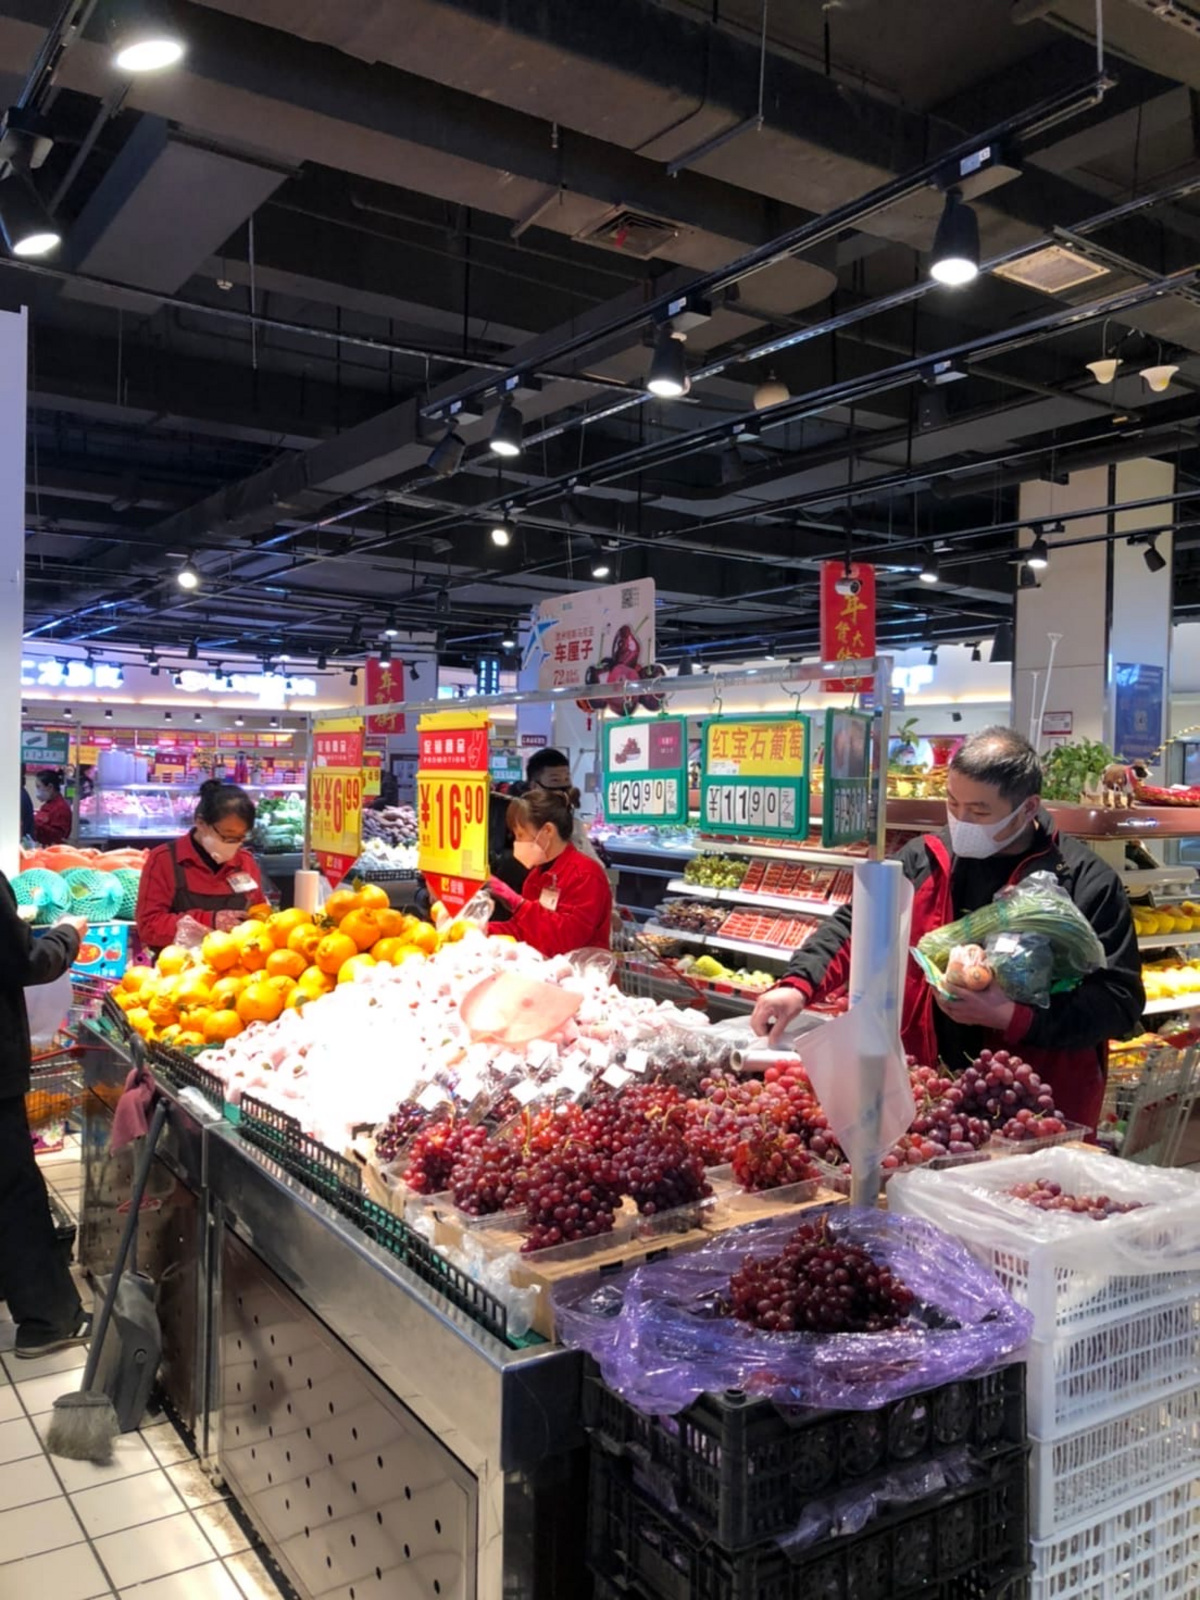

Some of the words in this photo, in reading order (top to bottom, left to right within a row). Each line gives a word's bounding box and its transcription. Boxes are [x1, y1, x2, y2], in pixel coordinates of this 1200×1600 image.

[554, 638, 594, 664] 车厘子
[712, 725, 803, 761] 红宝石葡萄
[423, 755, 466, 764] PROMOTION
